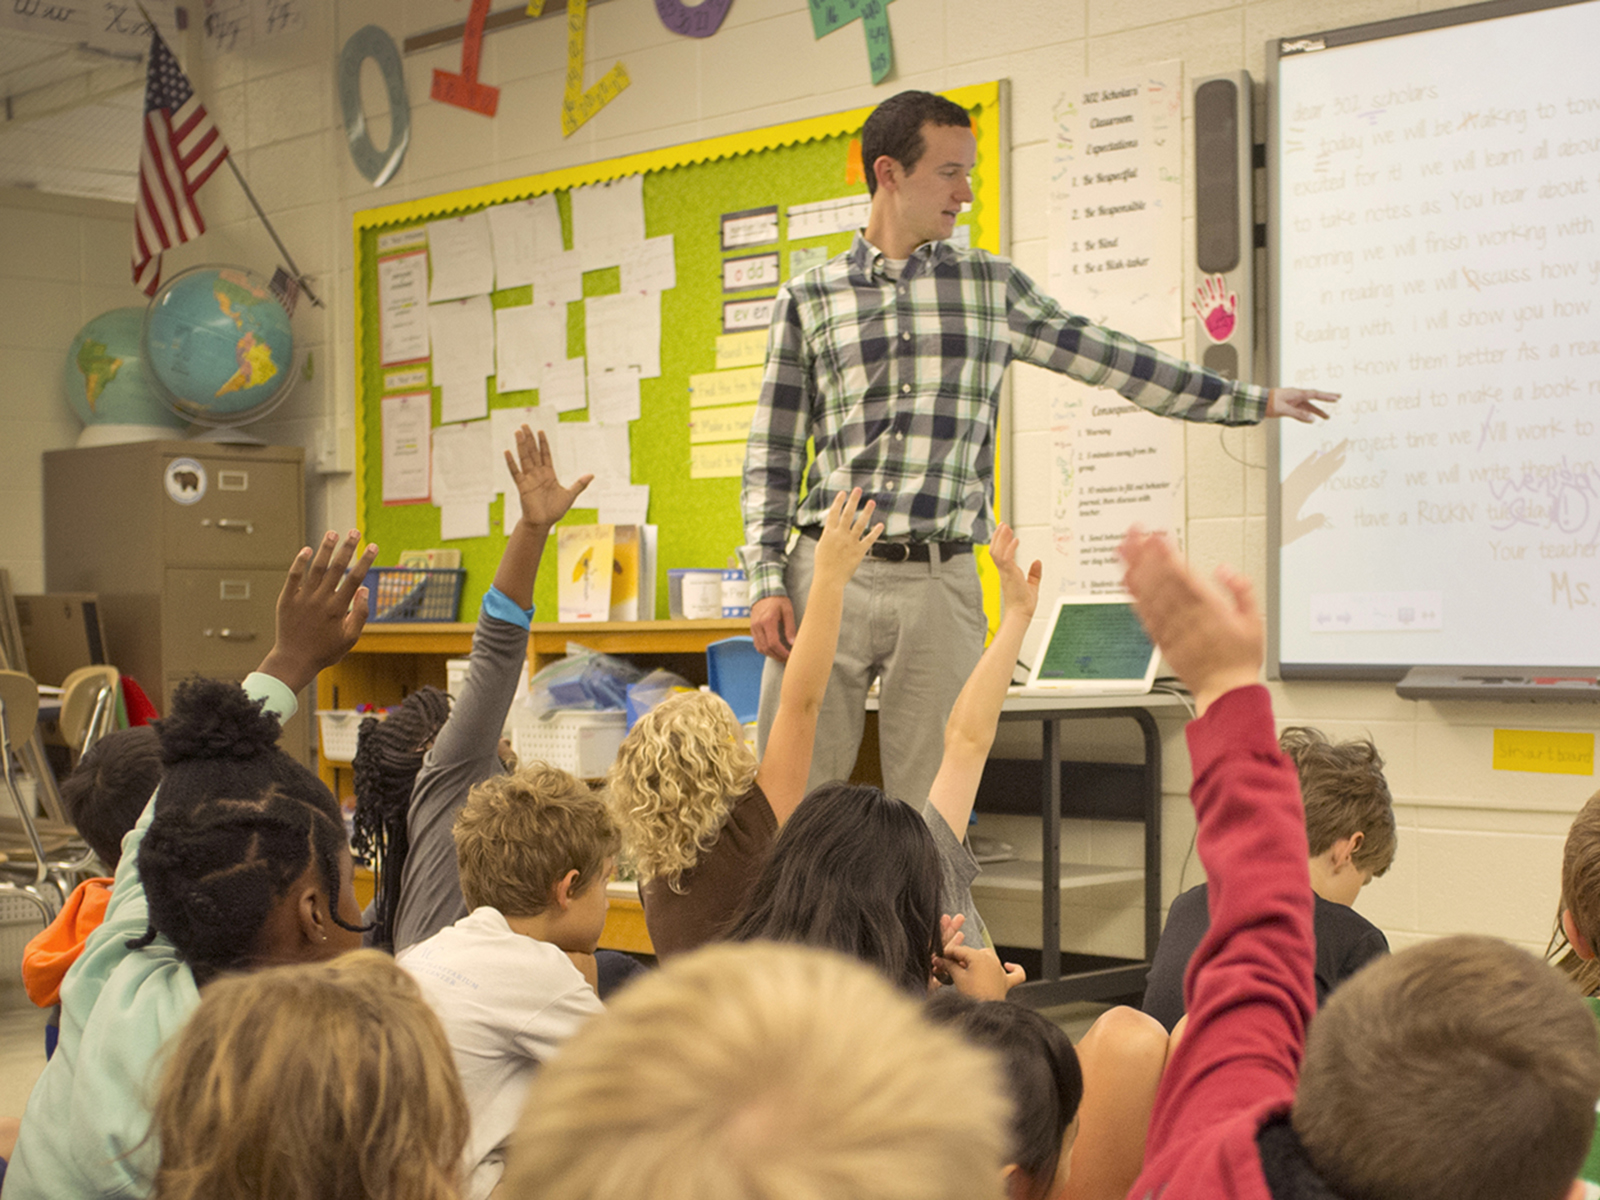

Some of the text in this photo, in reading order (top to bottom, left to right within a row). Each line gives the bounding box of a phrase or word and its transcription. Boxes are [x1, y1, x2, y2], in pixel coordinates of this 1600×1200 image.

[1334, 95, 1361, 115] 302
[1372, 130, 1394, 145] we
[1403, 119, 1427, 140] will
[1433, 119, 1452, 137] be
[1536, 102, 1556, 119] to
[1086, 139, 1138, 156] Expectations
[1354, 164, 1379, 187] for
[1421, 161, 1444, 177] we
[1453, 150, 1475, 173] will
[1484, 148, 1524, 168] learn
[1532, 138, 1549, 161] all
[1096, 167, 1138, 184] Respectful
[1098, 200, 1146, 217] Responsible
[1293, 215, 1311, 232] to
[1320, 208, 1356, 229] take
[1365, 203, 1413, 224] notes
[1420, 200, 1442, 216] as
[1451, 189, 1483, 211] You
[1492, 186, 1529, 205] hear
[1538, 175, 1589, 199] about
[1294, 215, 1594, 274] morning we will finish working with
[1340, 279, 1395, 308] reading
[1402, 279, 1426, 296] we
[1435, 269, 1458, 291] will
[1540, 260, 1579, 279] how
[1295, 321, 1350, 350] Reading
[1425, 308, 1448, 331] will
[1457, 308, 1504, 327] show
[1513, 304, 1544, 333] you
[1552, 298, 1592, 317] how
[1326, 361, 1343, 379] to
[1408, 351, 1448, 371] them
[1457, 346, 1507, 368] better
[1516, 340, 1540, 362] As
[1549, 343, 1560, 359] a
[1351, 398, 1378, 425] you
[1386, 388, 1421, 410] need
[1429, 389, 1448, 408] to
[1457, 383, 1503, 406] make
[1513, 385, 1523, 401] a
[1531, 376, 1580, 400] book
[1405, 431, 1439, 449] time
[1449, 429, 1471, 445] we
[1516, 417, 1566, 441] work
[1574, 417, 1595, 437] to
[1405, 470, 1427, 487] we
[1437, 463, 1460, 485] will
[1469, 463, 1511, 484] write
[1398, 512, 1408, 526] a
[1488, 540, 1529, 561] Your
[1550, 571, 1596, 610] Ms.
